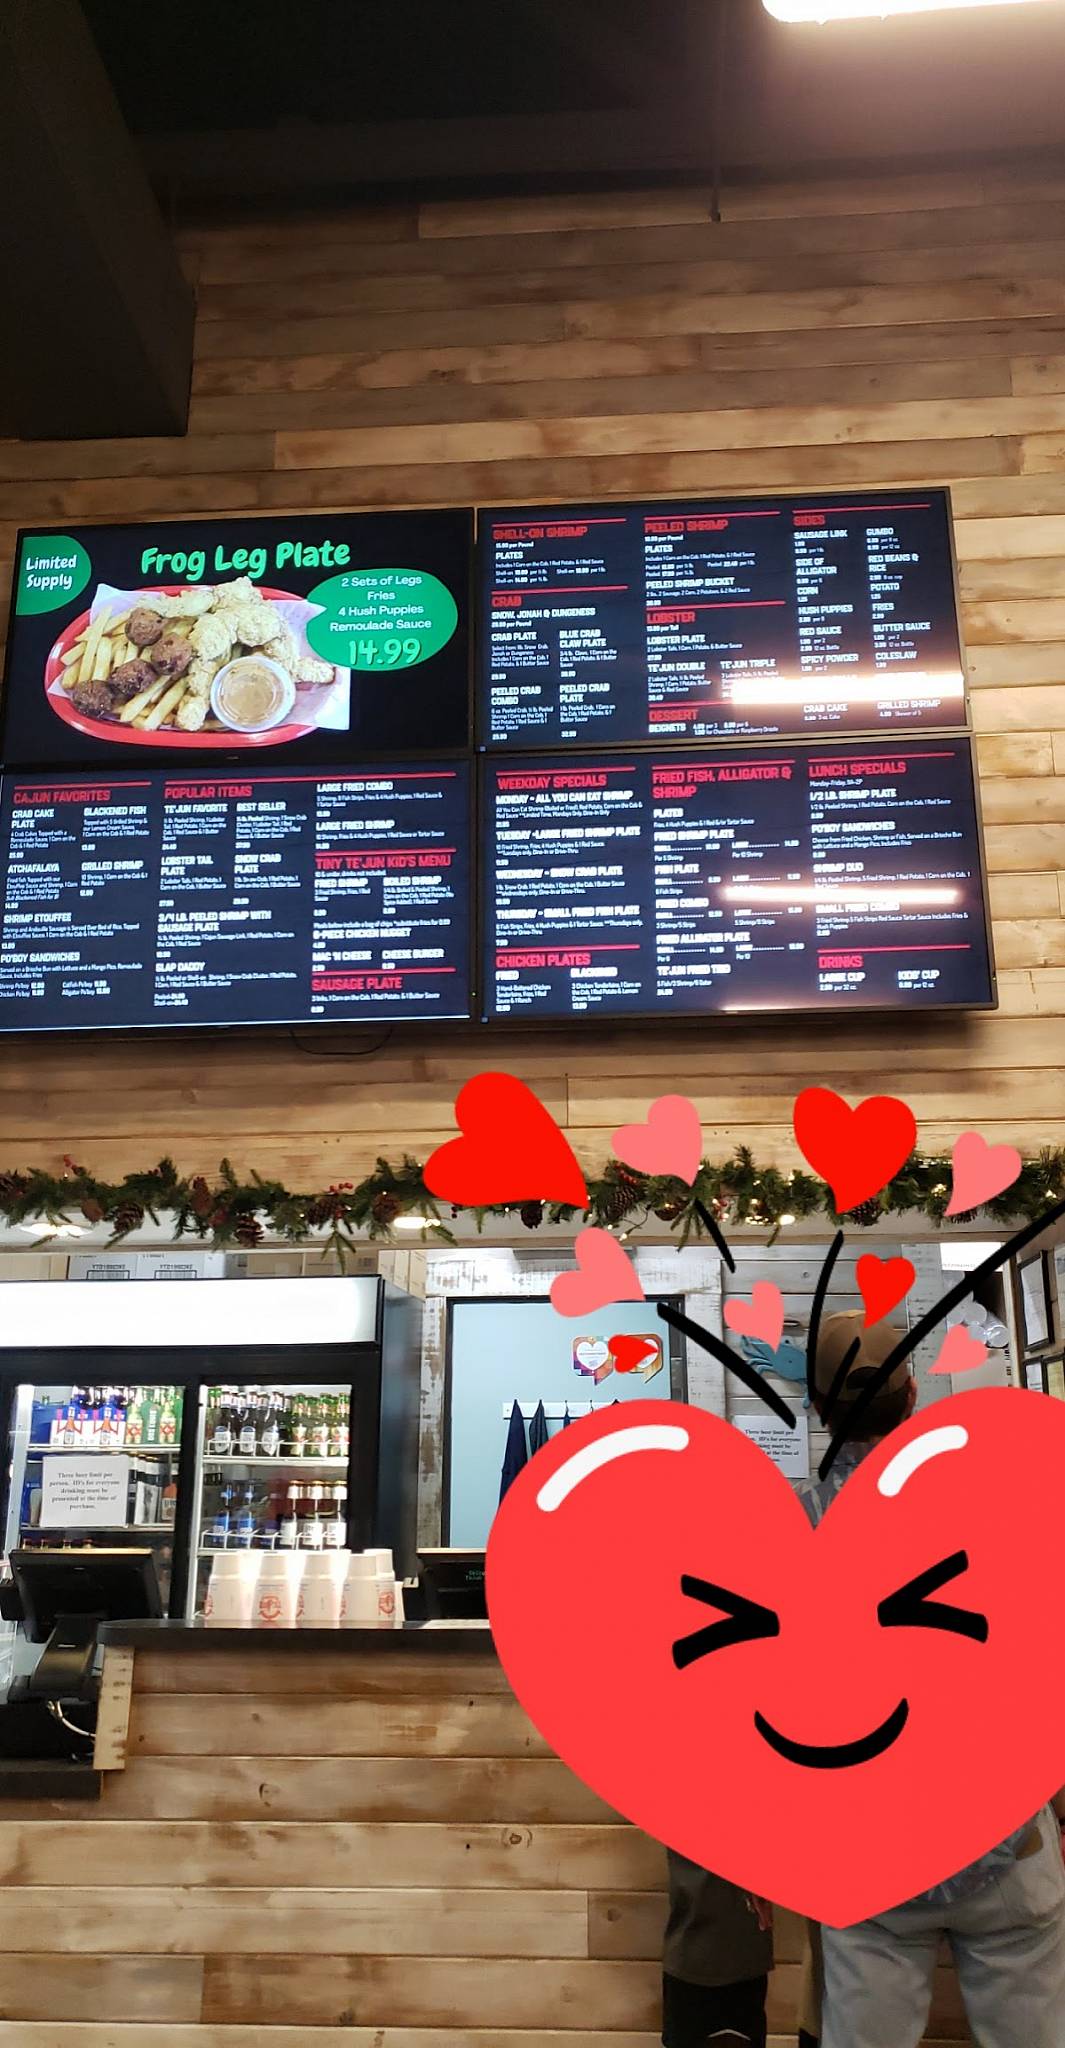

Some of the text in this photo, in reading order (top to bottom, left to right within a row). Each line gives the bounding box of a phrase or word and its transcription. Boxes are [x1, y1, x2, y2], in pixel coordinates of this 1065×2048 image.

[793, 515, 825, 525] SIDES
[645, 520, 728, 533] PEELED SHRIMP
[493, 527, 588, 540] SHELL-ON SHRIMP
[794, 531, 828, 539] SAUSAGE
[866, 528, 893, 536] GUMBO
[645, 545, 673, 553] PLATES
[25, 555, 76, 570] Limited
[141, 540, 351, 581] Frog Leg Plate
[868, 555, 883, 563] RED
[885, 554, 910, 562] BEANS
[796, 567, 837, 575] ALLIGATOR
[869, 564, 886, 572] RICE
[26, 573, 72, 589] Supply
[341, 575, 422, 587] 2 Sets of Legs
[646, 580, 672, 589] PEELED
[705, 577, 734, 587] BUCKET
[367, 591, 396, 601] Fries
[797, 587, 818, 595] CORN
[492, 596, 522, 607] CRAB
[338, 604, 424, 617] 4 Hush Puppies
[798, 604, 853, 615] HUSH PUPPIES
[872, 603, 894, 611] FRIES
[647, 612, 695, 624] LOBSTER
[330, 618, 432, 631] Remoulade Sauce
[873, 622, 930, 632] BUTTER SAUCE
[560, 629, 601, 639] BLUE CRAB
[799, 626, 841, 635] RED SAUCE
[491, 632, 537, 641] CRAB PLATE
[647, 635, 705, 644] LOBSTER PLATE
[560, 638, 606, 648] CLAW PLATE
[348, 638, 421, 666] 14.99
[876, 651, 916, 660] COLESLAW
[801, 656, 824, 664] SPICY
[491, 686, 541, 695] PEELED CRAB
[560, 683, 610, 693] PEELED CRAB
[491, 697, 518, 705] COMBO
[560, 694, 583, 703] PLATE
[804, 704, 848, 713] CRAB CAKE
[649, 709, 697, 721] DESSERT
[809, 762, 906, 777] LUNCH SPECIALS
[653, 772, 684, 784] FRIED
[718, 768, 781, 781] ALLIGATOR
[498, 775, 606, 789] WEEKDAY SPECIALS
[14, 790, 110, 804] CAJUN FAVORITES
[165, 786, 252, 799] POPULAR ITEMS
[653, 786, 697, 798] SHRIMP
[129, 806, 146, 814] FISH
[237, 802, 286, 812] BEST SELLER
[12, 809, 54, 818] CRAB CAKE
[11, 820, 35, 828] PLATE
[161, 856, 213, 865] LOBSTER TAIL
[315, 858, 343, 869] TINY
[418, 856, 450, 866] MENU
[8, 864, 60, 873] ATCHAFALAYA
[161, 867, 185, 875] PLATE
[235, 865, 259, 873] PLATE
[195, 922, 219, 931] PLATE
[30, 952, 80, 962] SANDWICHES
[496, 954, 591, 967] CHICKEN PLATES
[819, 956, 863, 968] DRINKS
[312, 977, 402, 991] SAUSAGE PLATE
